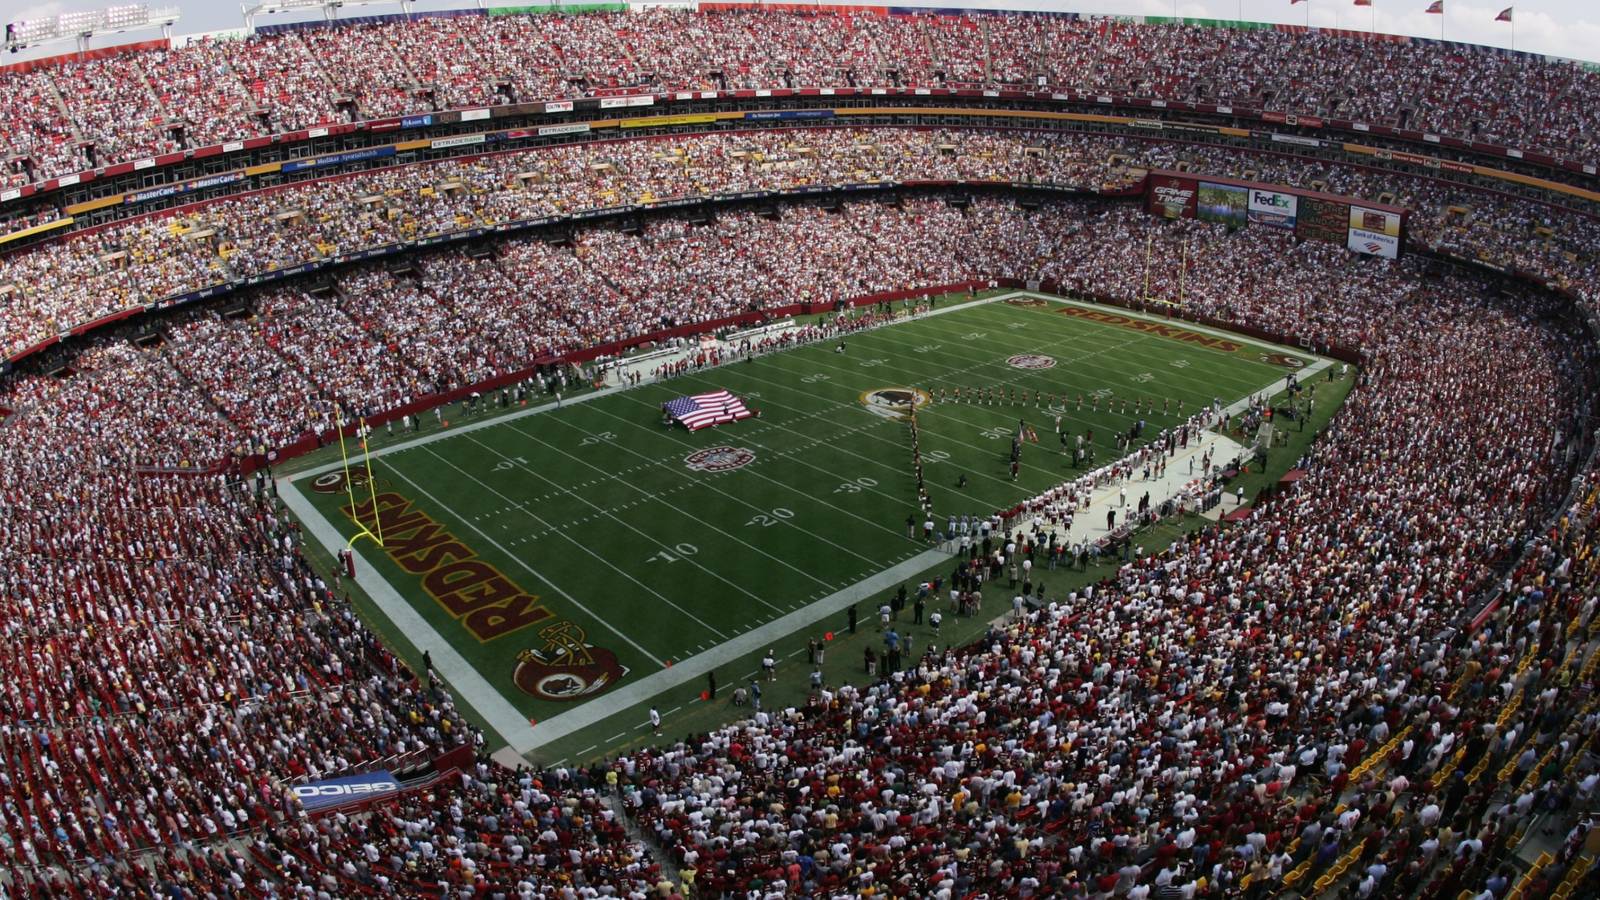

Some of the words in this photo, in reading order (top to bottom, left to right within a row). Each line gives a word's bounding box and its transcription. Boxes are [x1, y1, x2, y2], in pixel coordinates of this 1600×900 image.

[197, 174, 235, 187] MasterCard
[136, 187, 175, 200] MasterCard
[1154, 186, 1194, 198] GAME
[1157, 194, 1189, 204] TIME
[1254, 191, 1290, 208] FedEx
[1353, 230, 1367, 238] Bank
[1372, 234, 1395, 244] America
[1055, 306, 1246, 352] REDSKINS
[980, 426, 1013, 440] 50
[842, 477, 878, 493] 30
[752, 507, 794, 527] 20
[658, 543, 698, 563] 10
[340, 493, 556, 644] REDSKINS
[293, 782, 397, 797] GEICO
